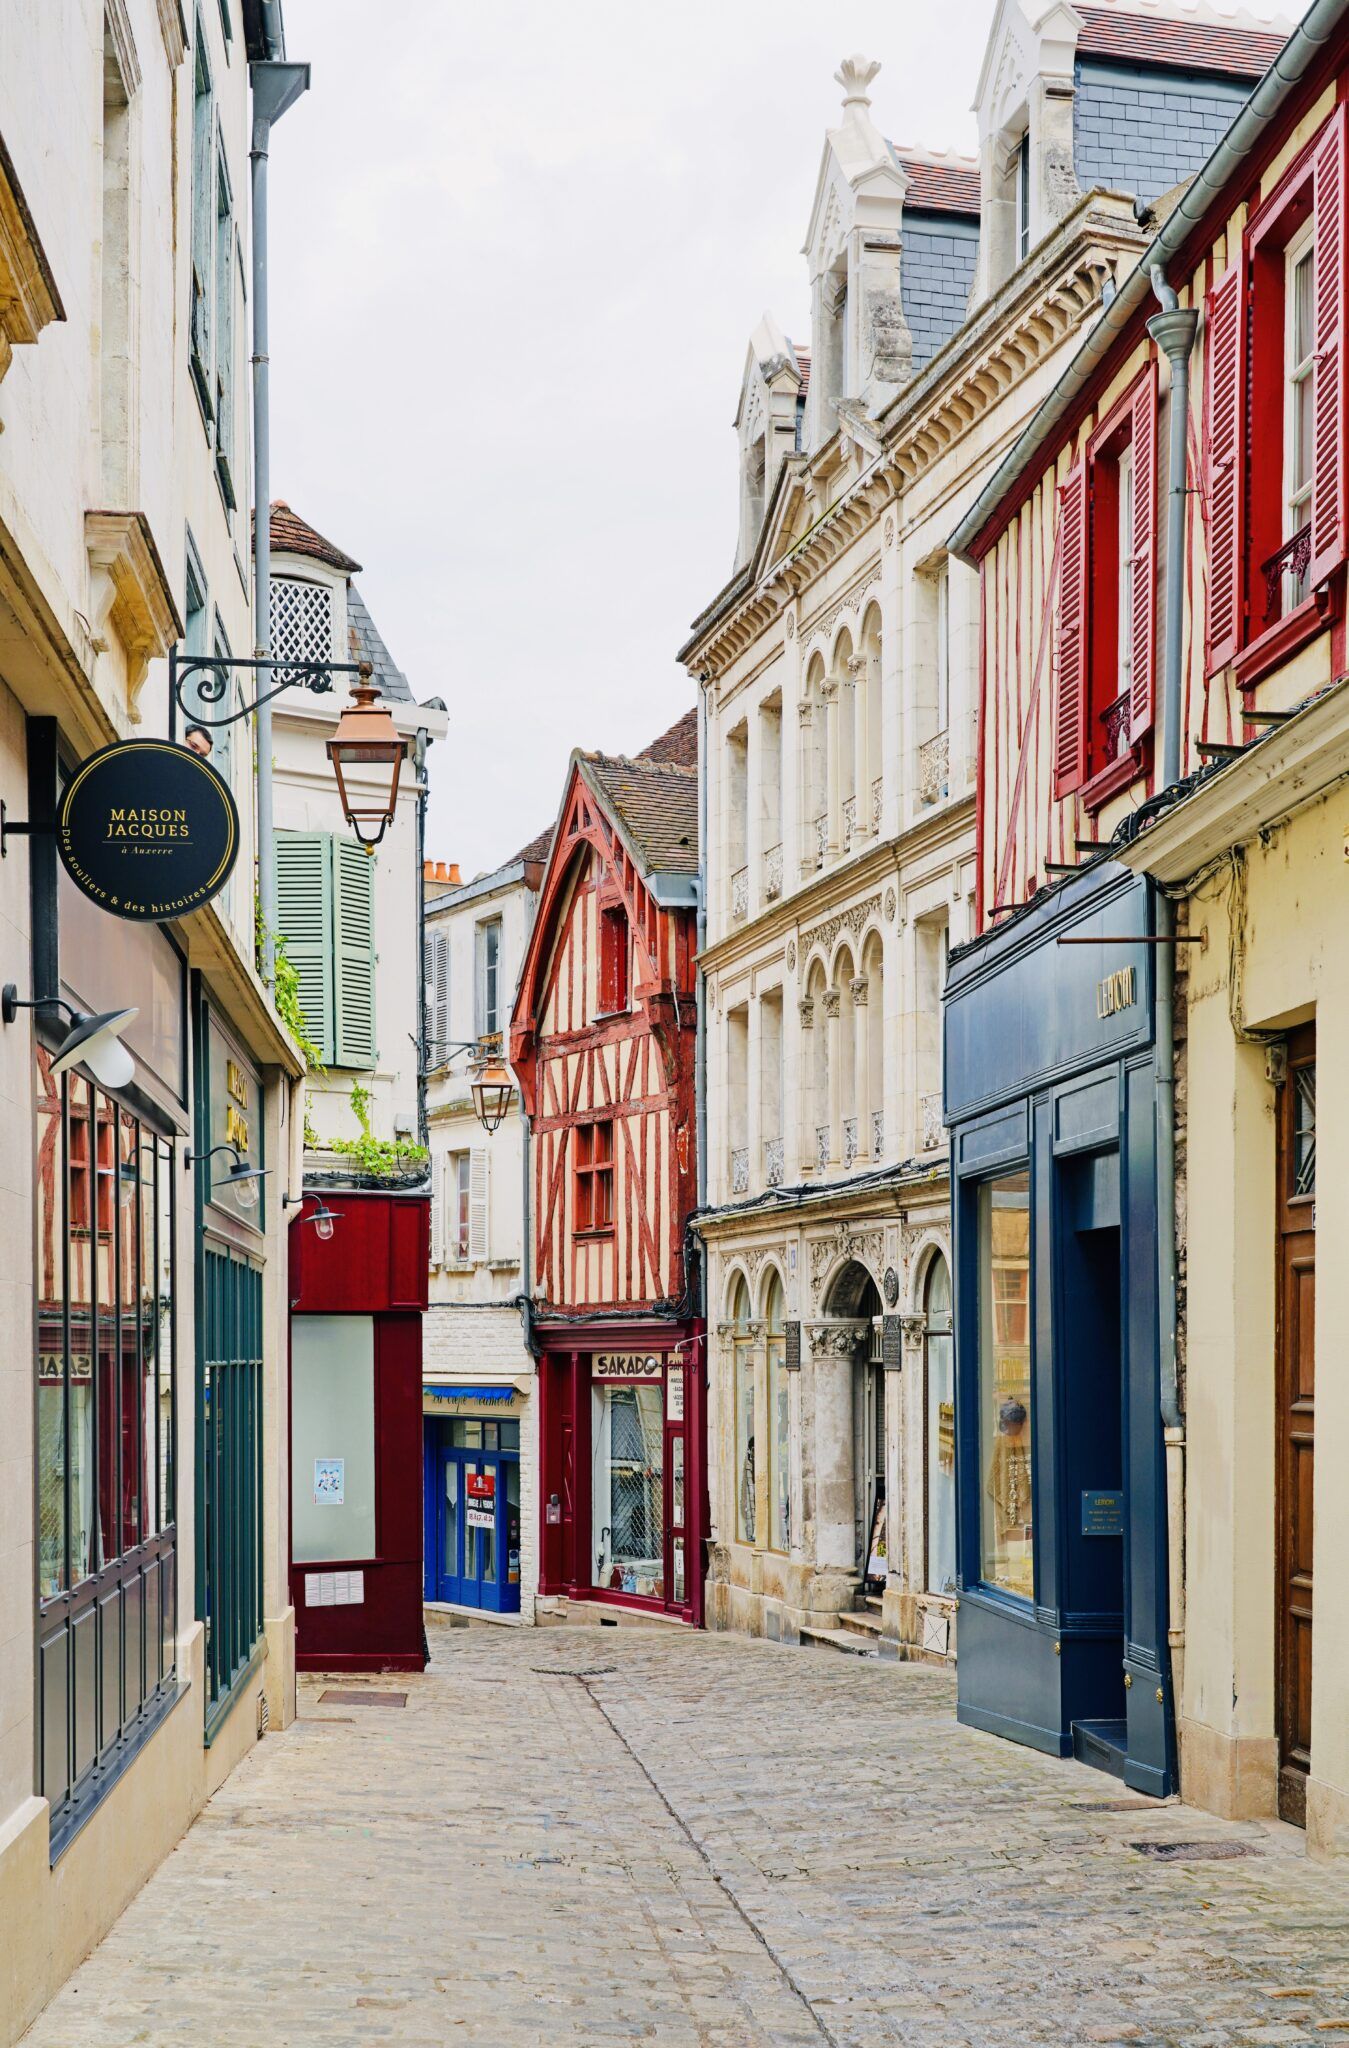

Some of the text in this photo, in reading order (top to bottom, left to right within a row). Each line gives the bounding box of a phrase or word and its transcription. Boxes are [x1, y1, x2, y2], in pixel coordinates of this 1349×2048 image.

[110, 808, 186, 822] MAISON
[107, 823, 190, 839] JACQUES
[121, 845, 173, 855] à Auxerre
[61, 829, 206, 913] Des souliers & des histoires
[598, 1355, 658, 1376] SAKADO
